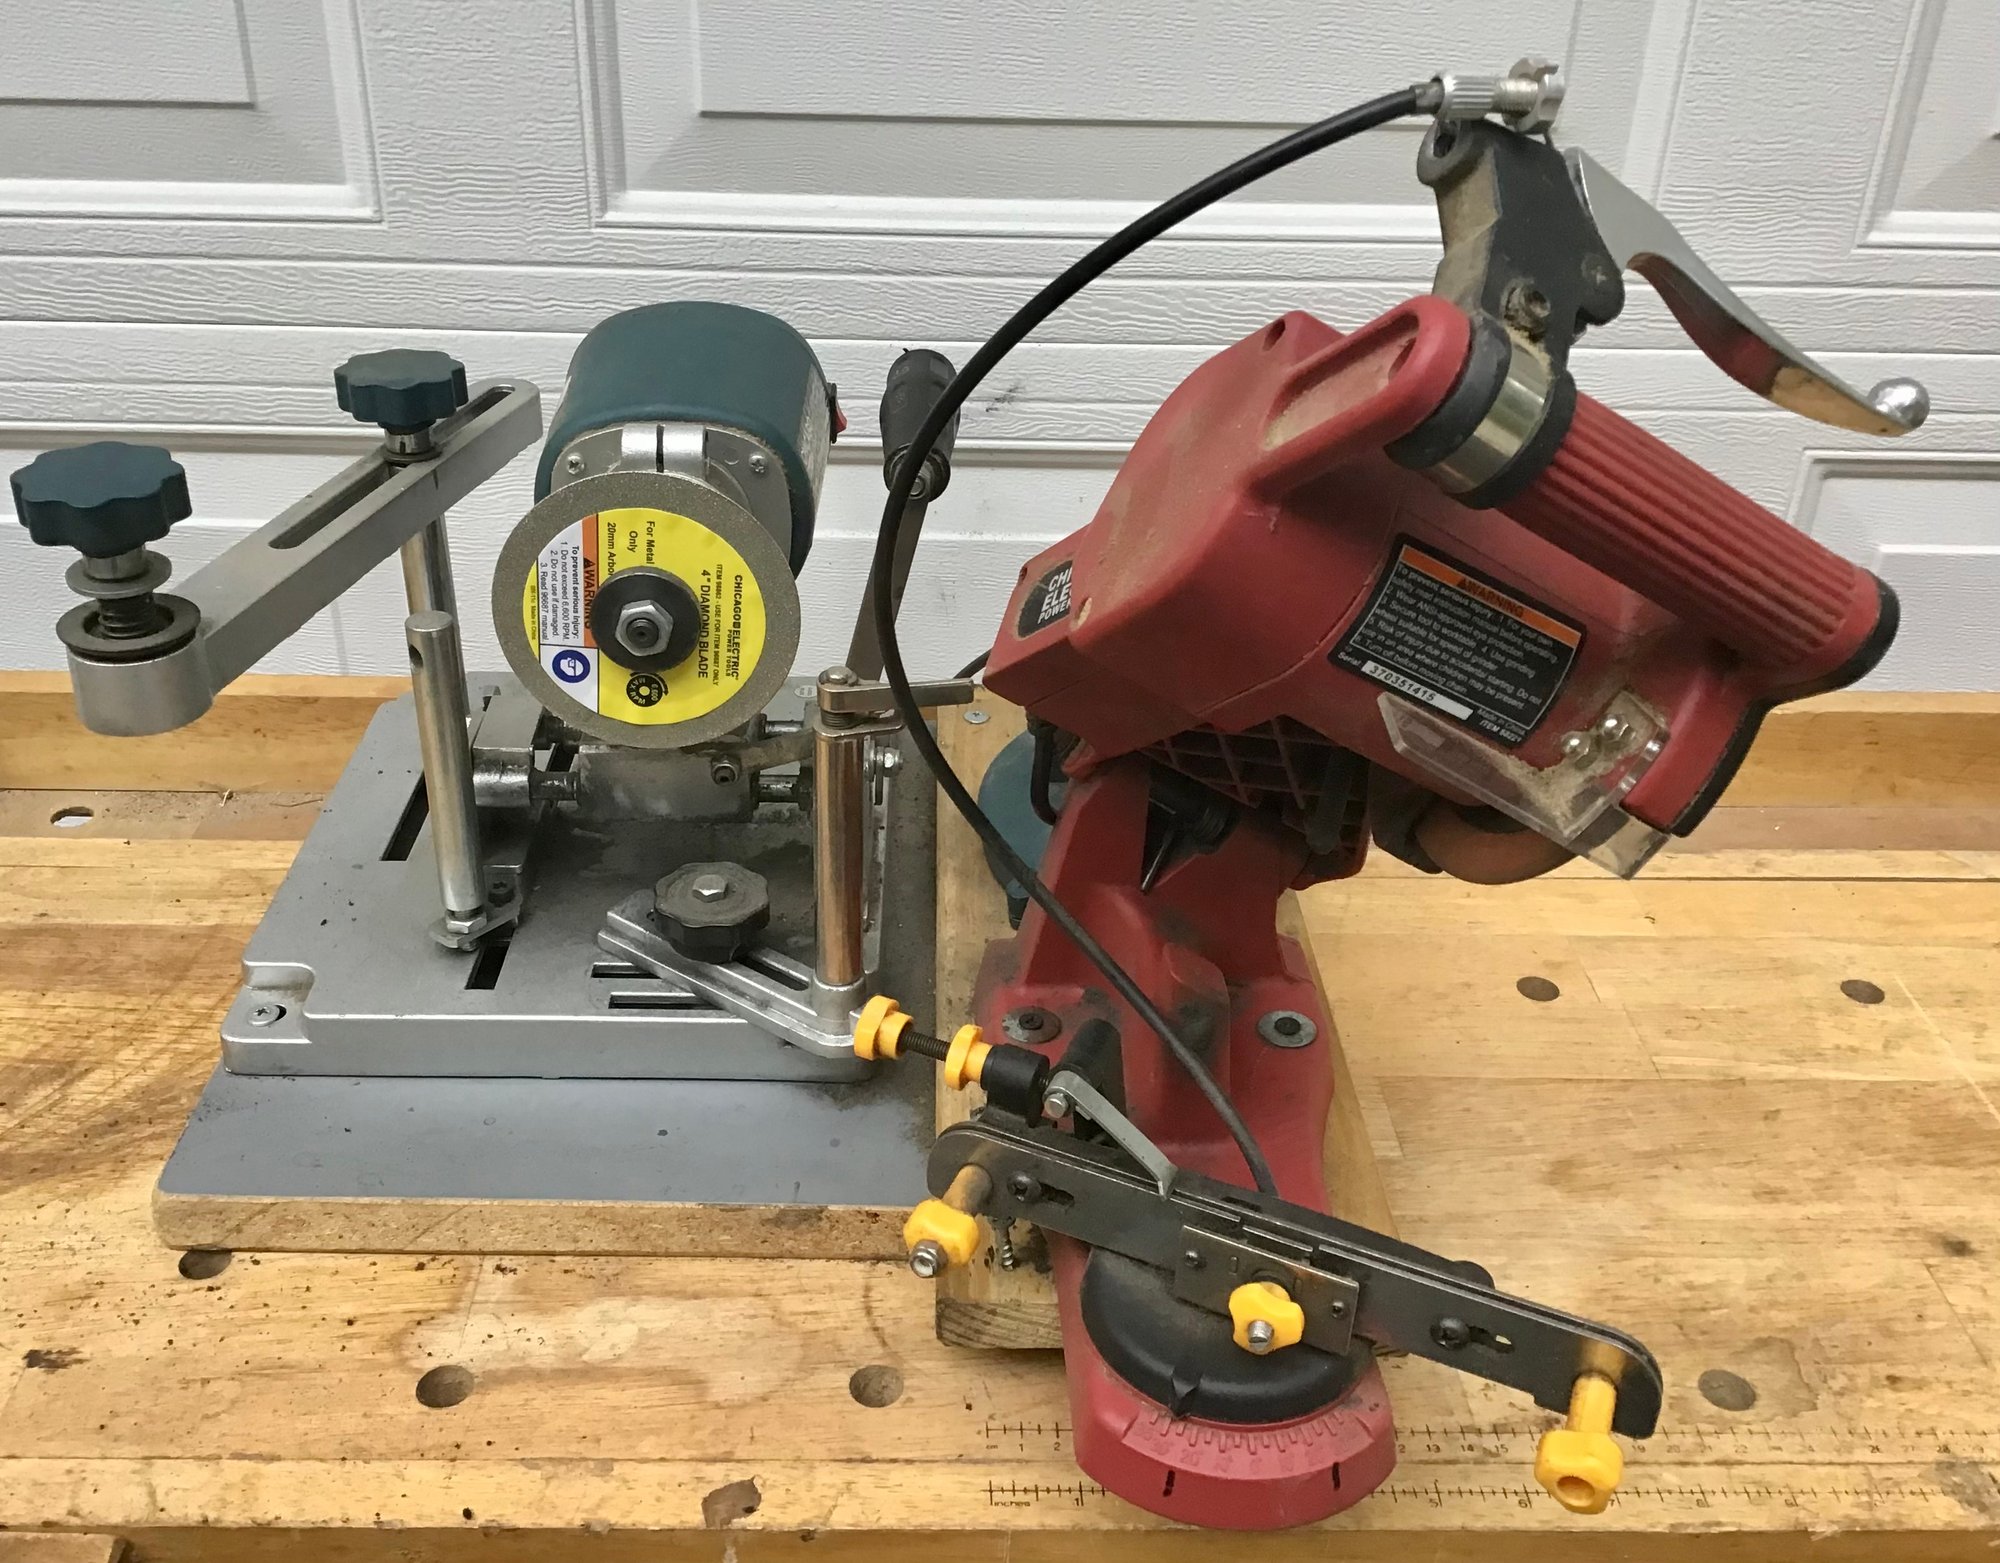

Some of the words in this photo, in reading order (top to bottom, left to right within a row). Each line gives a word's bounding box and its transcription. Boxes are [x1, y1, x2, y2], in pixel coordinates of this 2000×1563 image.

[607, 522, 616, 549] 20mm
[626, 530, 638, 552] Only
[646, 521, 655, 536] For
[561, 550, 567, 559] Do
[572, 545, 578, 554] To
[646, 539, 654, 564] Metal
[551, 559, 557, 568] Do
[571, 556, 579, 584] prevent
[699, 585, 710, 637] DIAMOND
[1395, 565, 1408, 576] To
[1406, 570, 1440, 592] prevent
[1438, 585, 1470, 606] serious
[1505, 618, 1521, 631] For
[1518, 626, 1537, 641] your
[1535, 634, 1554, 648] own
[1462, 579, 1526, 619] WARNING
[550, 604, 559, 637] damaged.
[571, 615, 580, 638] injury:
[1394, 589, 1417, 606] Wear
[1470, 629, 1488, 643] eye
[1373, 605, 1399, 623] wheel
[1426, 631, 1440, 643] for
[1437, 637, 1464, 655] speed
[1461, 648, 1473, 659] of
[1388, 600, 1418, 620] Secure
[1416, 613, 1433, 627] tool
[1431, 621, 1442, 631] to
[1488, 649, 1507, 663] Use
[1503, 657, 1536, 679] grinding
[698, 641, 708, 678] BLADE
[1360, 626, 1377, 639] use
[1375, 633, 1386, 643] in
[1383, 637, 1397, 648] an
[1395, 642, 1415, 657] area
[1413, 651, 1439, 668] where
[1437, 662, 1470, 683] children
[1466, 677, 1485, 692] may
[1483, 685, 1496, 696] be
[1363, 639, 1384, 654] Turn
[1380, 646, 1395, 659] off
[1392, 652, 1419, 671] before
[1416, 665, 1447, 686] moving
[1376, 620, 1396, 635] Risk
[1392, 628, 1405, 640] of
[1423, 643, 1442, 657] due
[1439, 651, 1450, 661] to
[1447, 655, 1488, 680] accidental
[1514, 687, 1530, 700] Do
[1527, 693, 1543, 706] not
[629, 677, 645, 689] MAX
[1368, 663, 1437, 702] 370351415
[629, 691, 645, 704] RPM
[1477, 717, 1501, 734] ITEM
[1053, 1441, 1061, 1451] 2
[1427, 1443, 1441, 1454] 13
[1494, 1443, 1509, 1454] 15
[1517, 1498, 1529, 1509] 6
